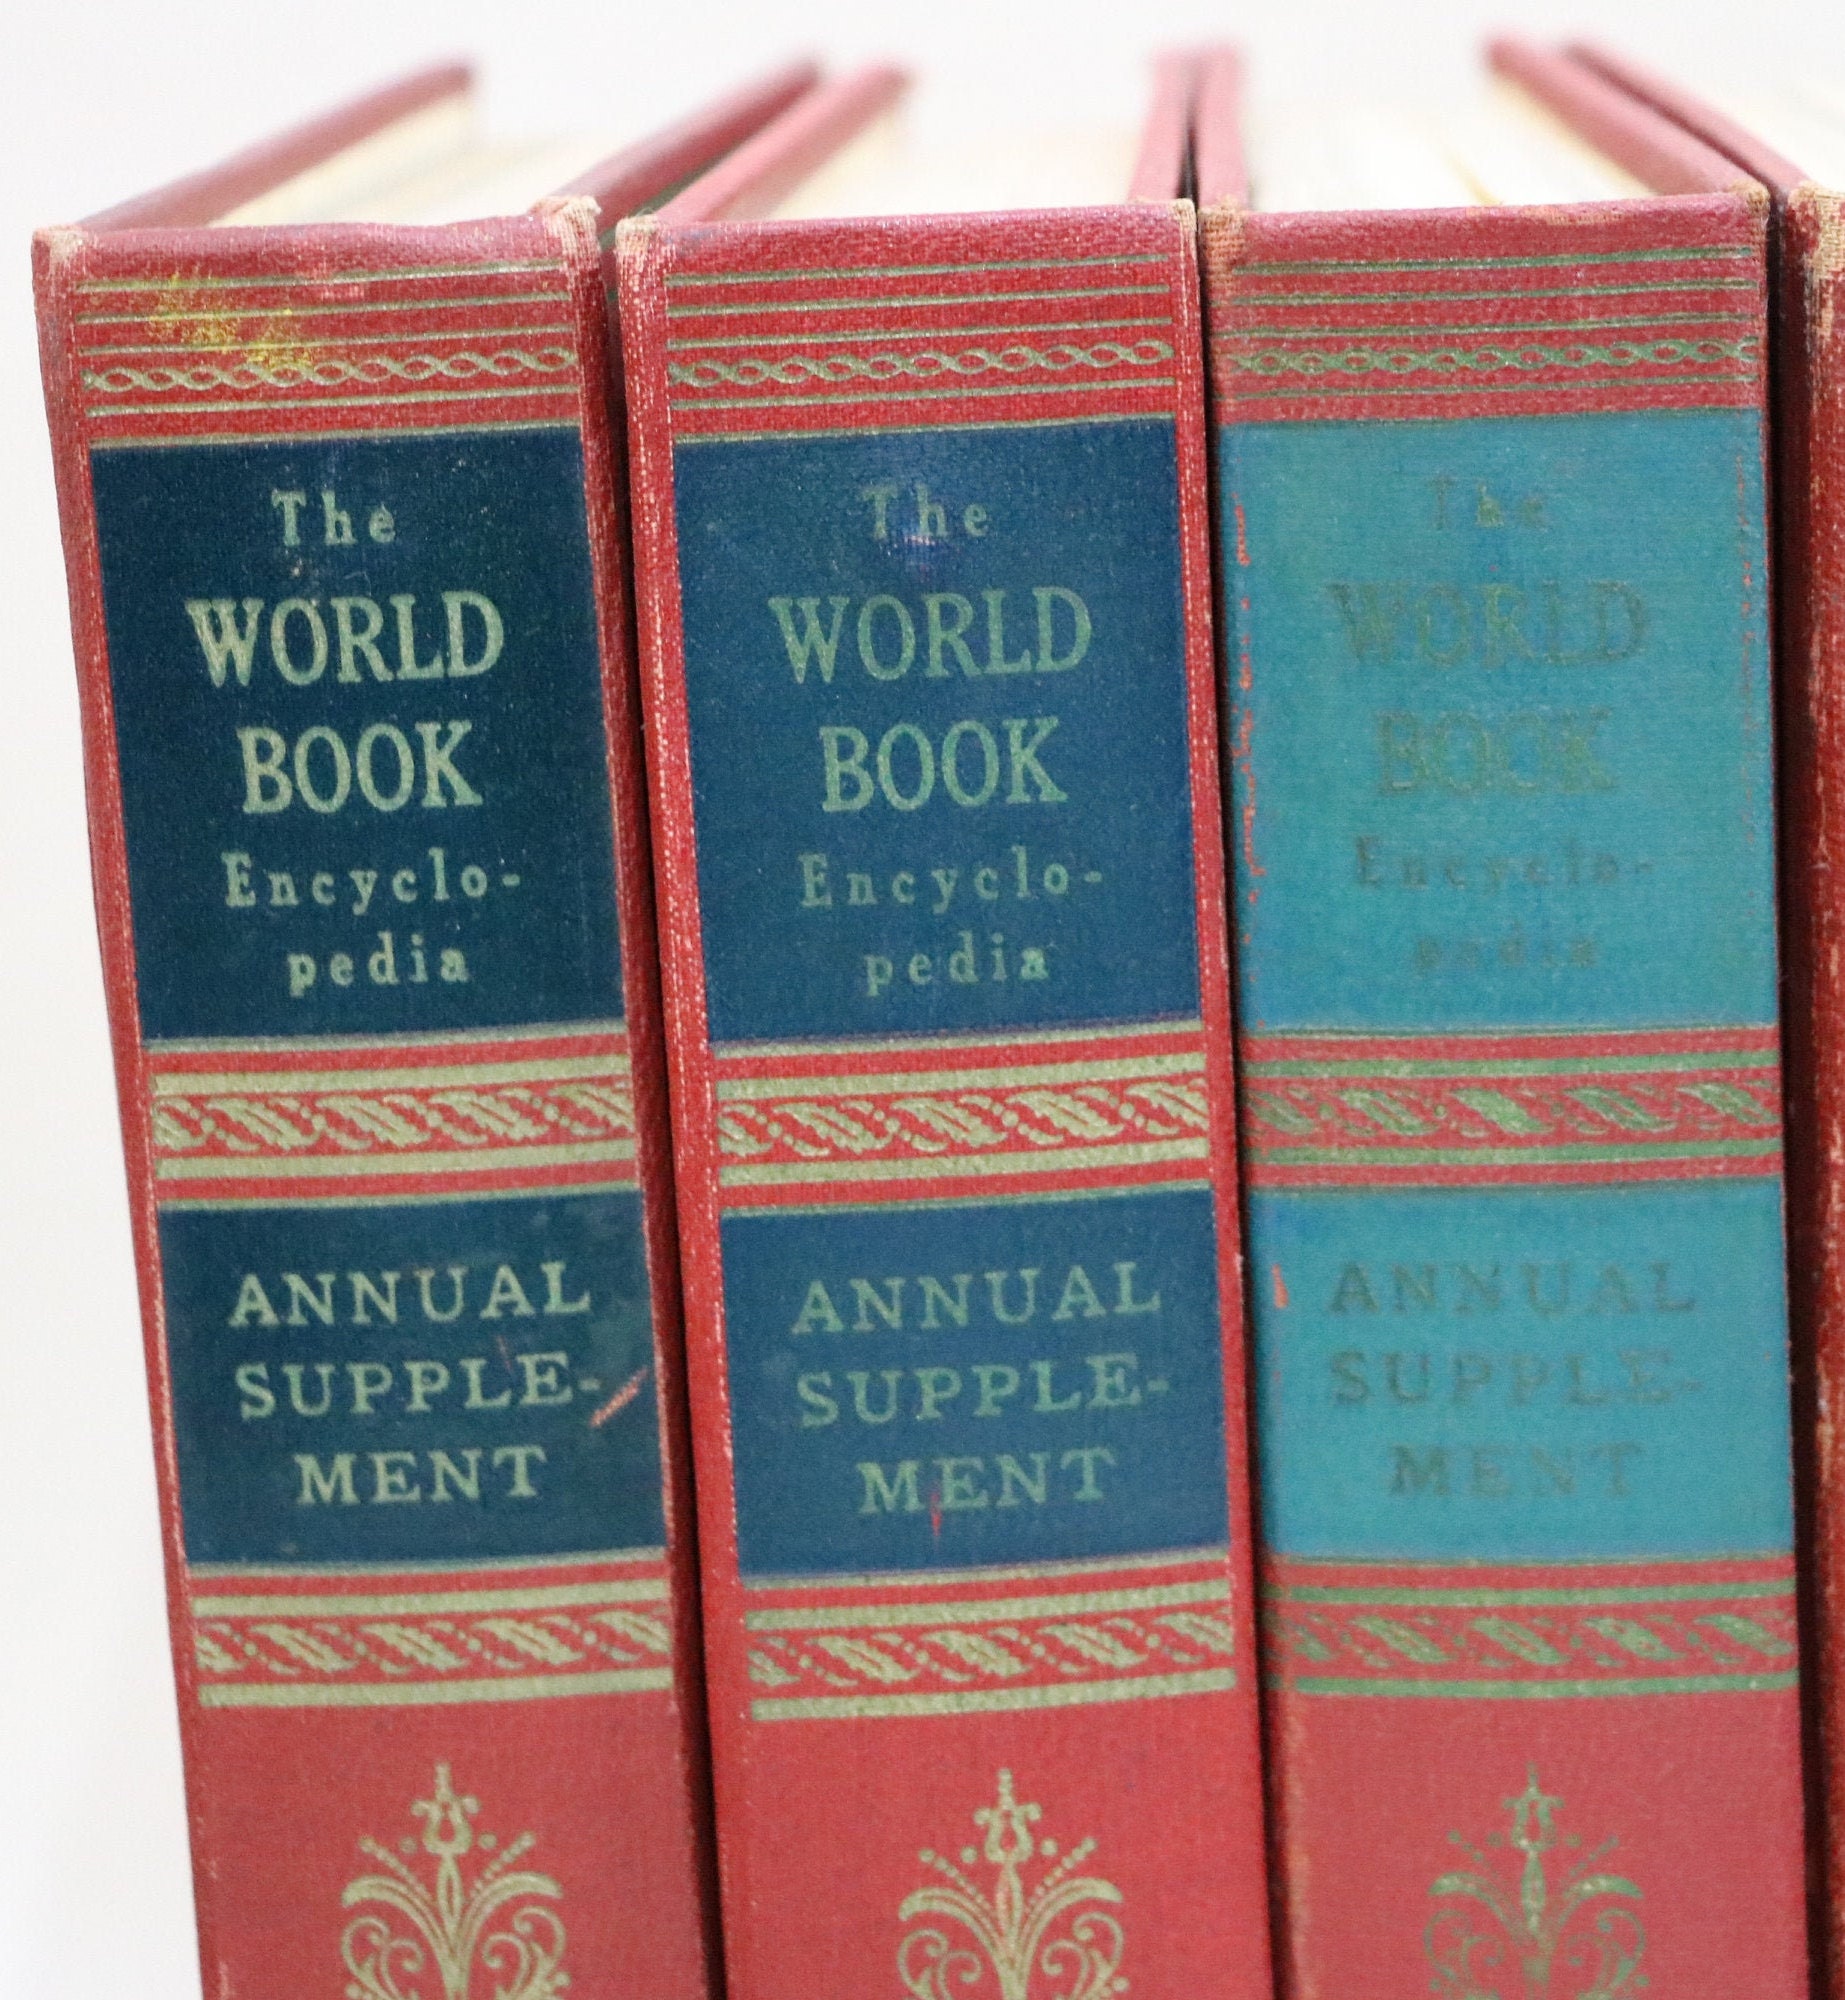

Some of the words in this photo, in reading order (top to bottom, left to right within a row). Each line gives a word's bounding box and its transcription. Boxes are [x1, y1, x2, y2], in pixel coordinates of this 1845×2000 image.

[271, 489, 398, 547] The
[857, 484, 992, 540] The
[184, 590, 504, 687] WORLD
[768, 586, 1092, 685] WORLD
[1325, 580, 1651, 668] WORLD
[236, 720, 484, 814] BOOK
[818, 716, 1069, 813] BOOK
[1375, 706, 1617, 795] BOOK
[221, 847, 521, 915] Encyclo-
[799, 846, 1102, 913] Encyclo-
[287, 932, 469, 997] pedia
[863, 930, 1050, 998] pedia
[228, 1261, 591, 1327] ANNUAL
[791, 1261, 1161, 1333] ANNUAL
[1327, 1260, 1697, 1316] ANNUAL
[234, 1351, 598, 1421] SUPPLE-
[796, 1351, 1170, 1429] SUPPLE-
[1328, 1347, 1702, 1408] SUPPLE-
[294, 1445, 547, 1505] MENT
[855, 1446, 1116, 1514] MENT
[1389, 1440, 1646, 1497] MENT
